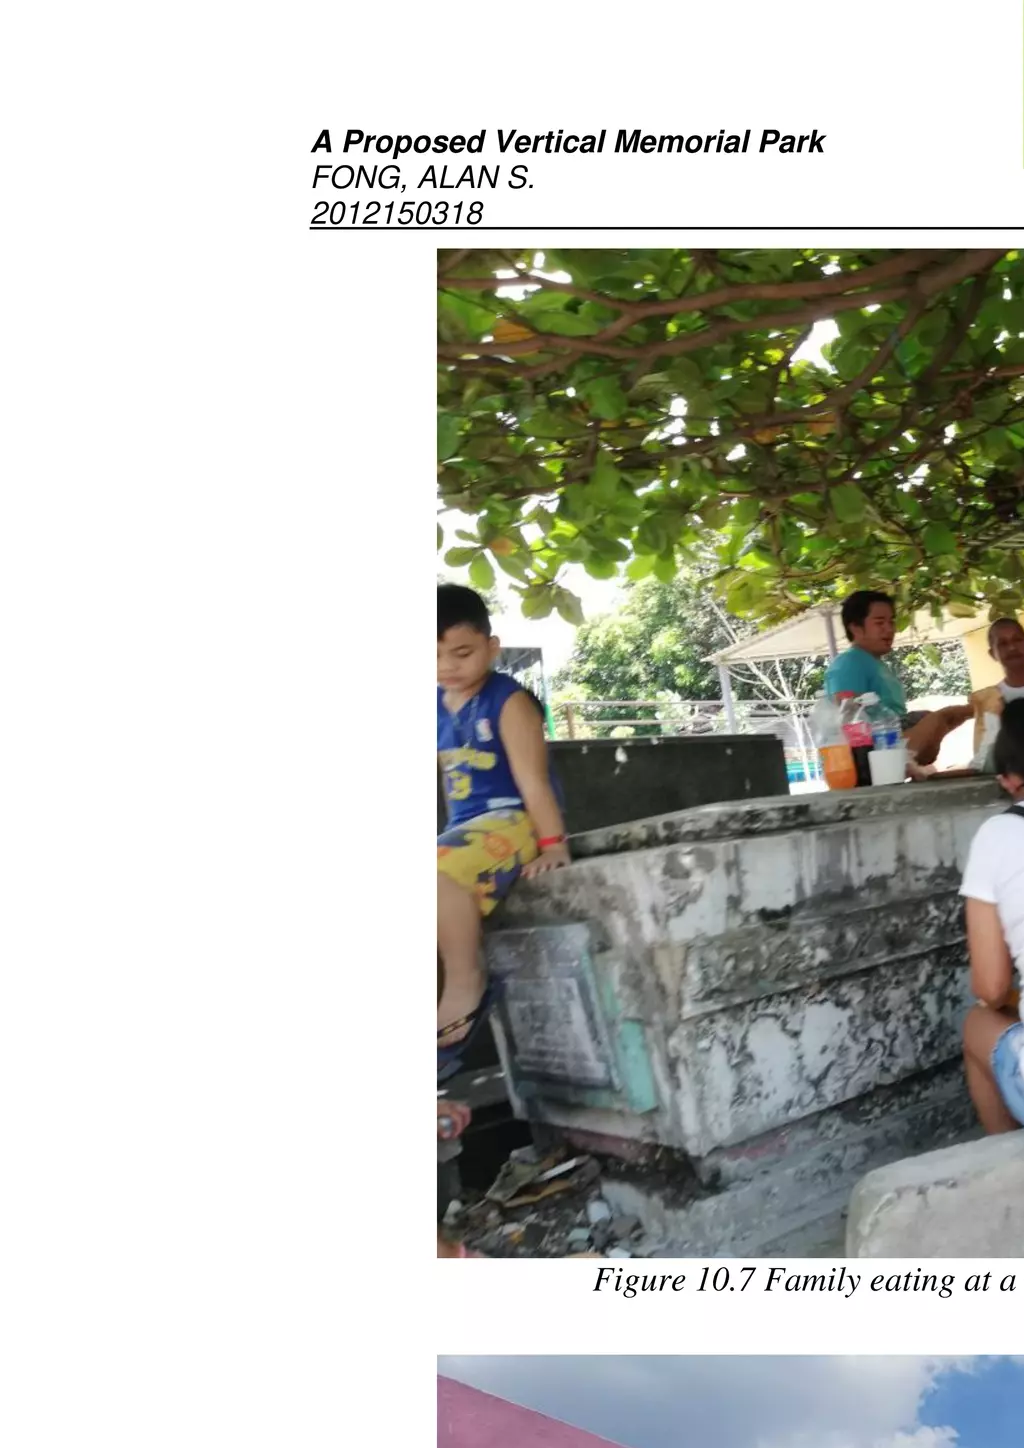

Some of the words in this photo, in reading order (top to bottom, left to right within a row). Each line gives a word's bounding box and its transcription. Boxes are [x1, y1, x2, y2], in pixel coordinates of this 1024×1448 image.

[311, 130, 331, 153] A
[343, 130, 486, 158] Proposed
[498, 130, 606, 154] Vertical
[615, 130, 751, 154] Memorial
[759, 130, 827, 154] Park
[313, 165, 406, 193] FONG,
[417, 165, 500, 189] ALAN
[508, 165, 534, 190] S.
[311, 201, 484, 226] 2012150318
[593, 1267, 686, 1299] Figure
[699, 1267, 757, 1292] 10.7
[765, 1267, 861, 1299] Family
[871, 1268, 956, 1299] eating
[965, 1272, 992, 1292] at
[1000, 1275, 1016, 1292] a
